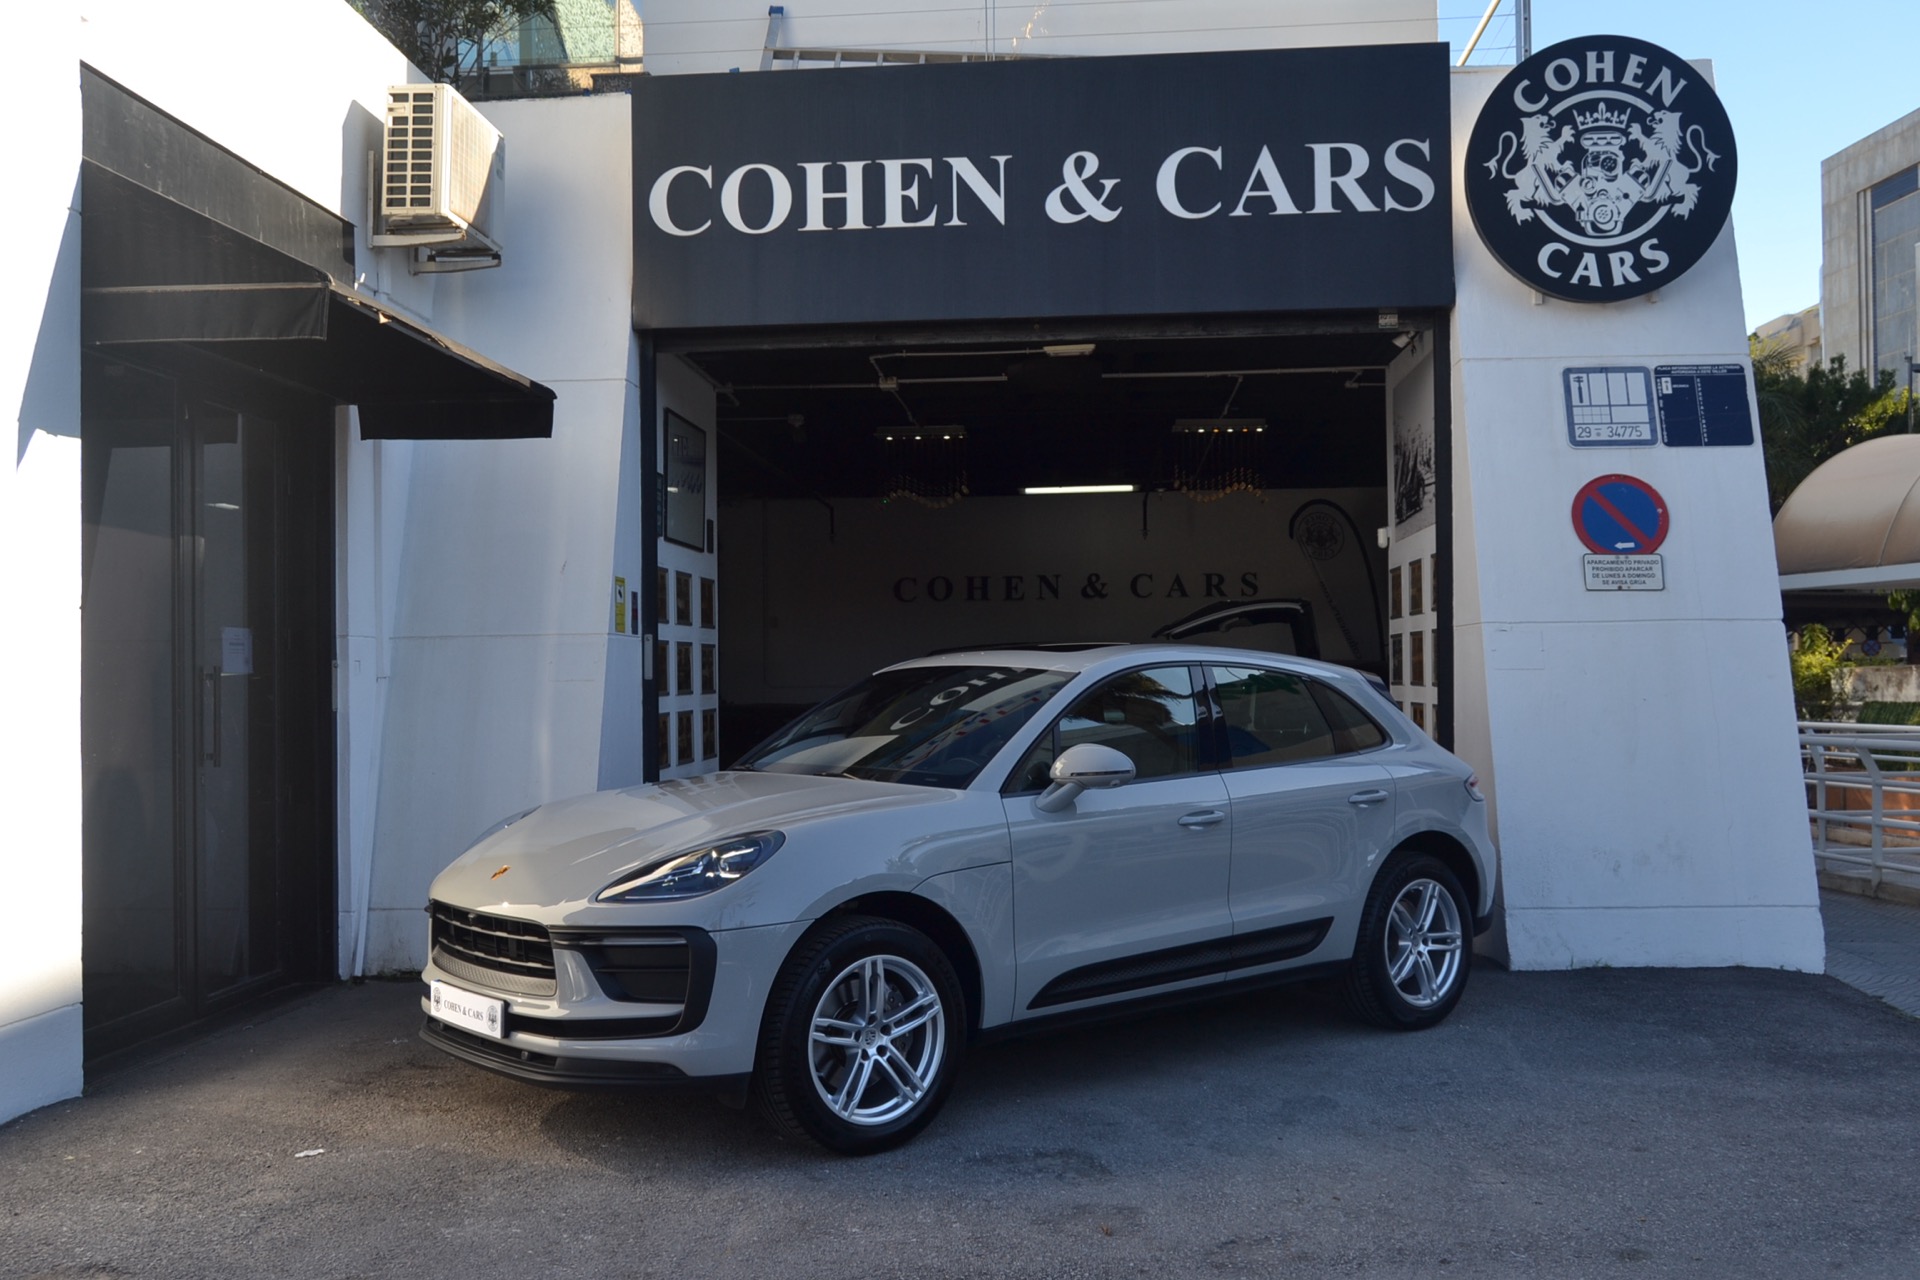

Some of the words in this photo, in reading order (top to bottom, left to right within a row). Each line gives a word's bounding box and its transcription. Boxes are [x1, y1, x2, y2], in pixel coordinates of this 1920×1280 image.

[1513, 51, 1688, 113] COHEN
[648, 155, 1012, 237] COHEN
[1045, 151, 1122, 224] &
[1155, 138, 1435, 219] CARS
[1537, 237, 1670, 288] CARS
[1576, 426, 1592, 439] 29
[1606, 425, 1643, 438] 34775
[893, 574, 1061, 603] COHEN
[1080, 573, 1108, 599] &
[1130, 572, 1258, 599] CARS
[443, 999, 461, 1013] COHEN
[462, 1006, 467, 1016] &
[467, 1008, 484, 1021] CARS
